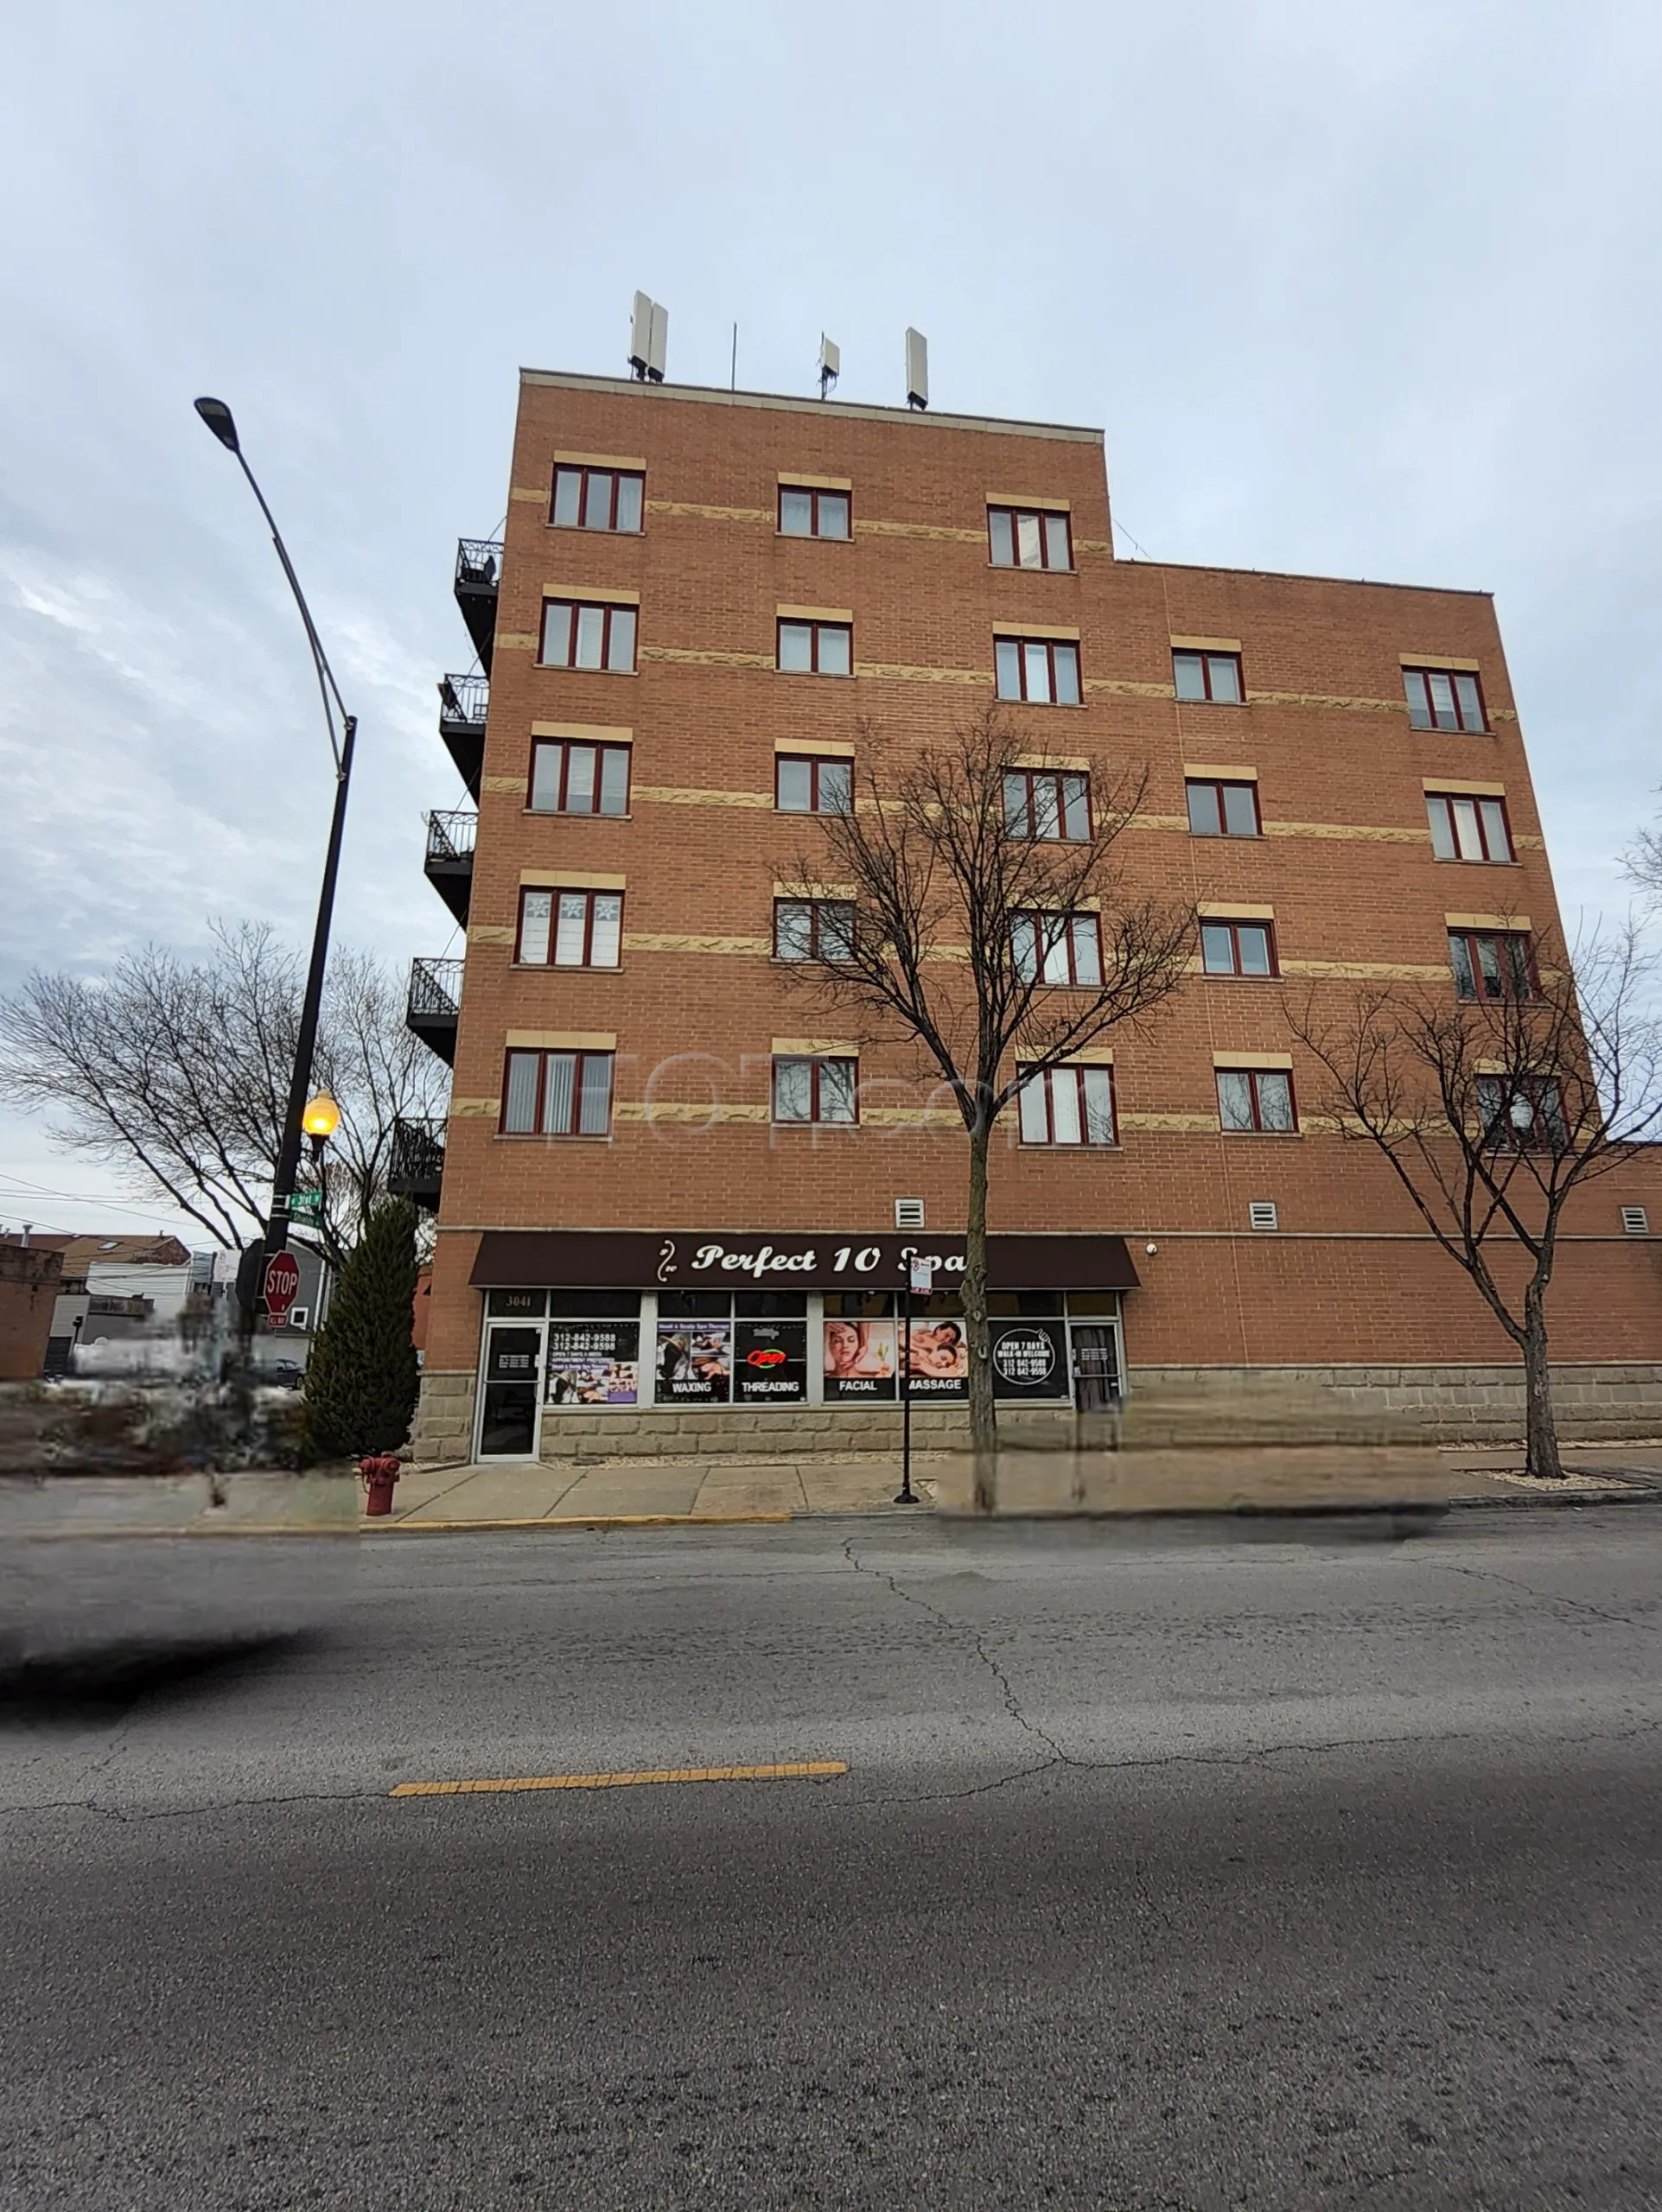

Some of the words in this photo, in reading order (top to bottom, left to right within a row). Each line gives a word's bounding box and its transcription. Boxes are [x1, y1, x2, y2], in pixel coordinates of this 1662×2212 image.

[691, 1244, 817, 1278] Perfect
[833, 1247, 881, 1273] 10
[267, 1270, 297, 1296] STOP
[506, 1296, 532, 1307] 3041
[553, 1333, 616, 1342] 312-842-9588
[552, 1342, 616, 1351] 312-842-9598
[1002, 1341, 1020, 1351] OPEN
[1021, 1341, 1026, 1351] 7
[1026, 1341, 1046, 1351] DAYS
[672, 1382, 712, 1393] WAXING
[742, 1382, 799, 1393] THREADING
[839, 1380, 878, 1391] FACIAL
